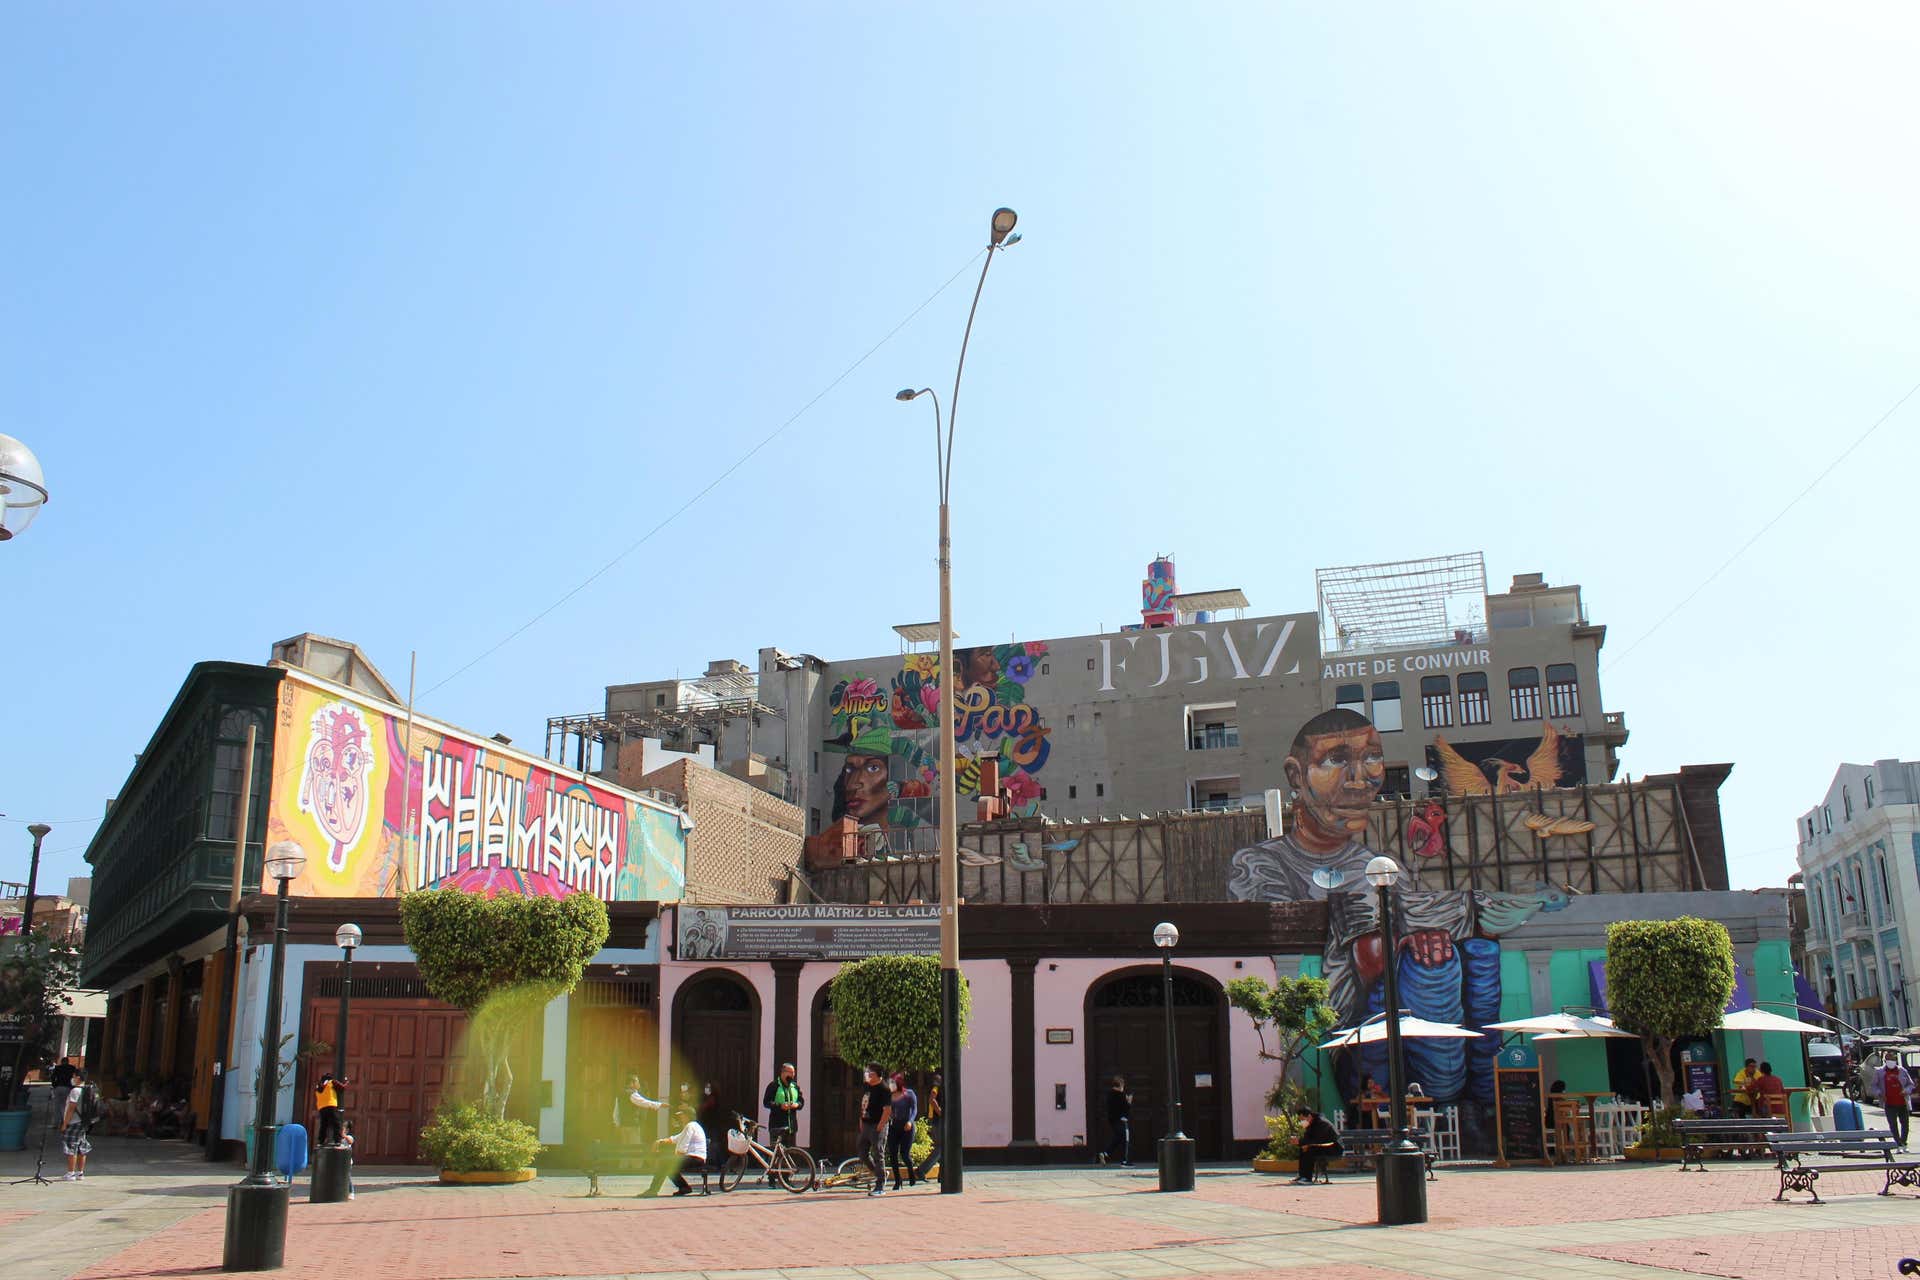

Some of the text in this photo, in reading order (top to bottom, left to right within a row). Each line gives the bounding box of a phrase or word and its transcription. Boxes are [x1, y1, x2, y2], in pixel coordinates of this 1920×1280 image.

[1323, 650, 1491, 679] ARTE DE CONVIVIR
[831, 688, 888, 716] Amor
[732, 907, 810, 919] PARROQUIA
[815, 906, 864, 918] MATRIZ
[867, 907, 892, 918] DEL
